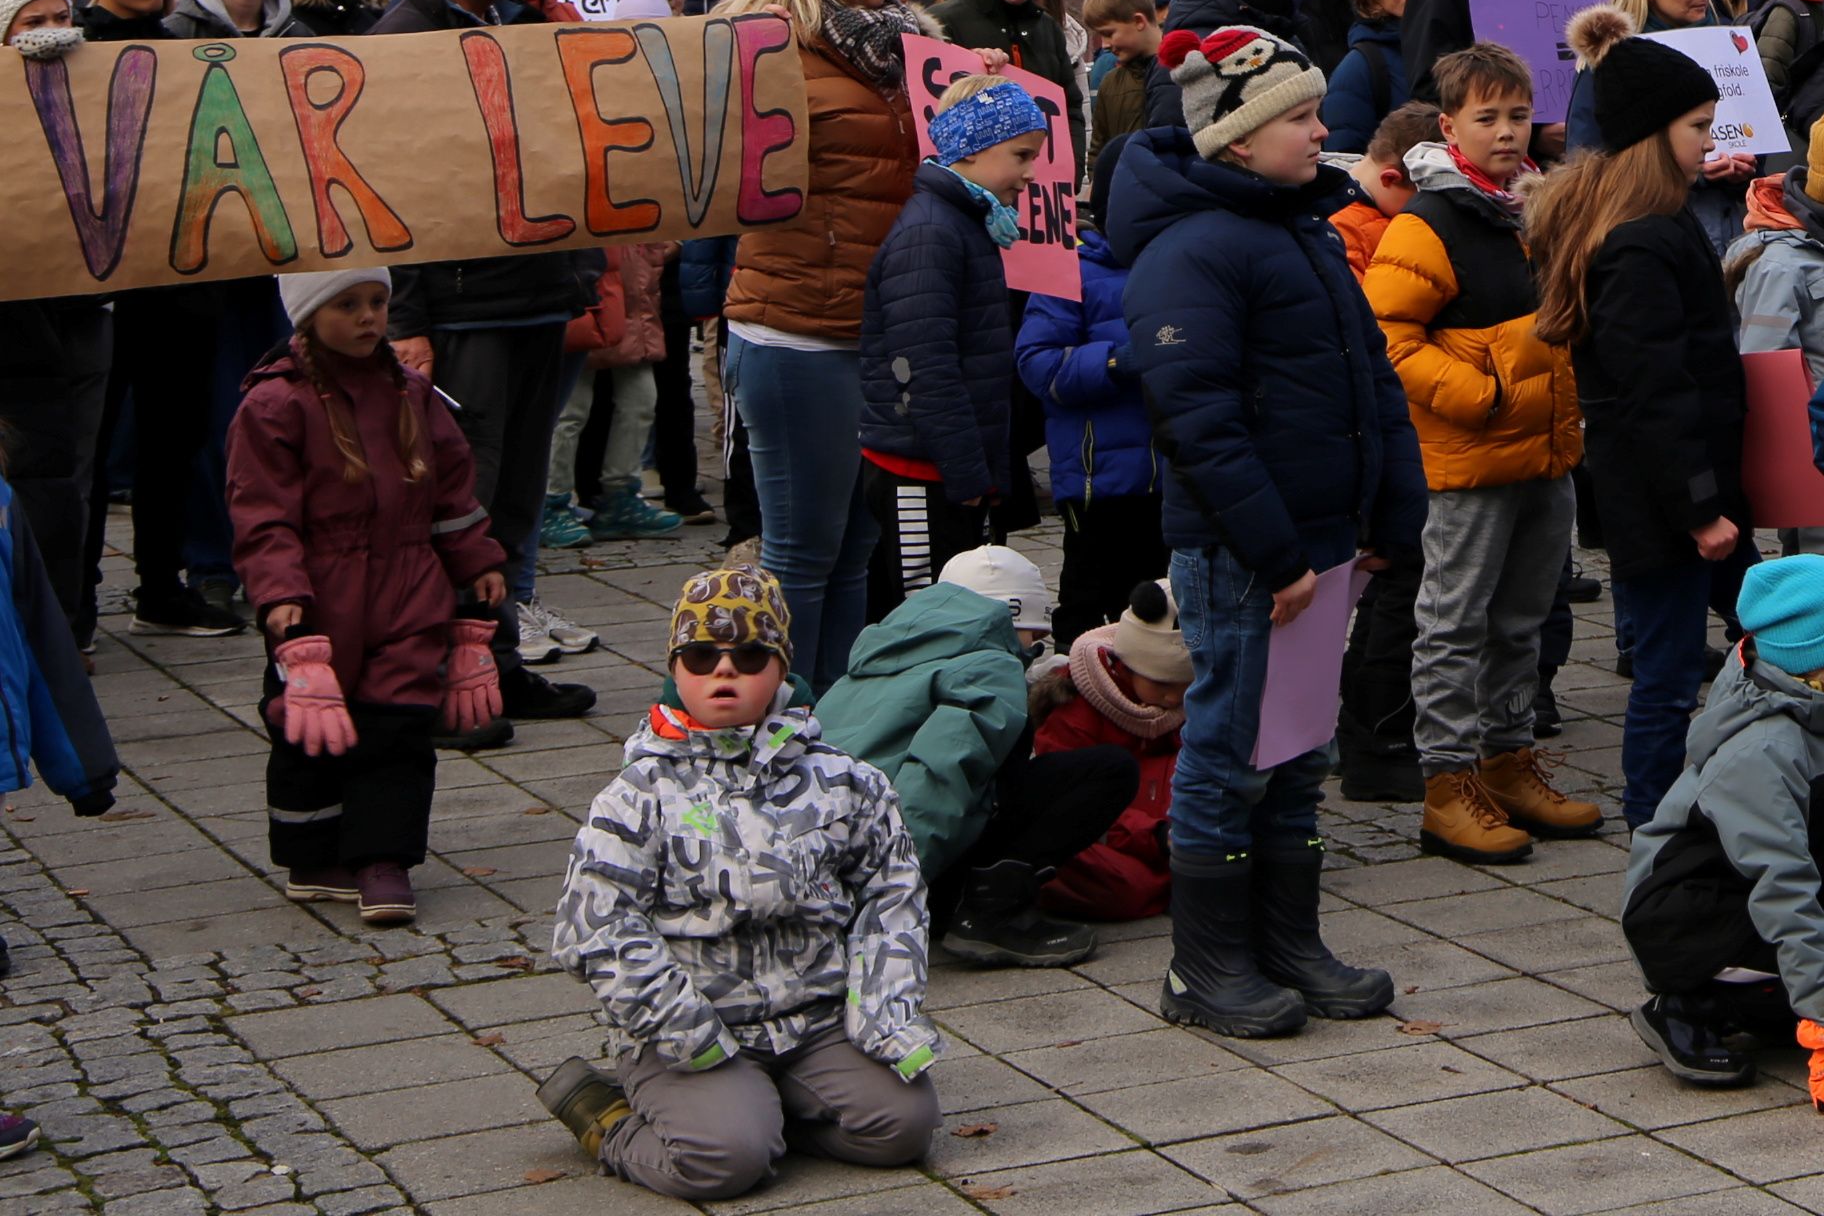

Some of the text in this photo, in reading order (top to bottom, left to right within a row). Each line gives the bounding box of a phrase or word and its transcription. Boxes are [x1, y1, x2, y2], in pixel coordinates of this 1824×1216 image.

[1714, 64, 1750, 78] friskole
[24, 40, 413, 282] VÅR
[458, 12, 803, 247] LEVE
